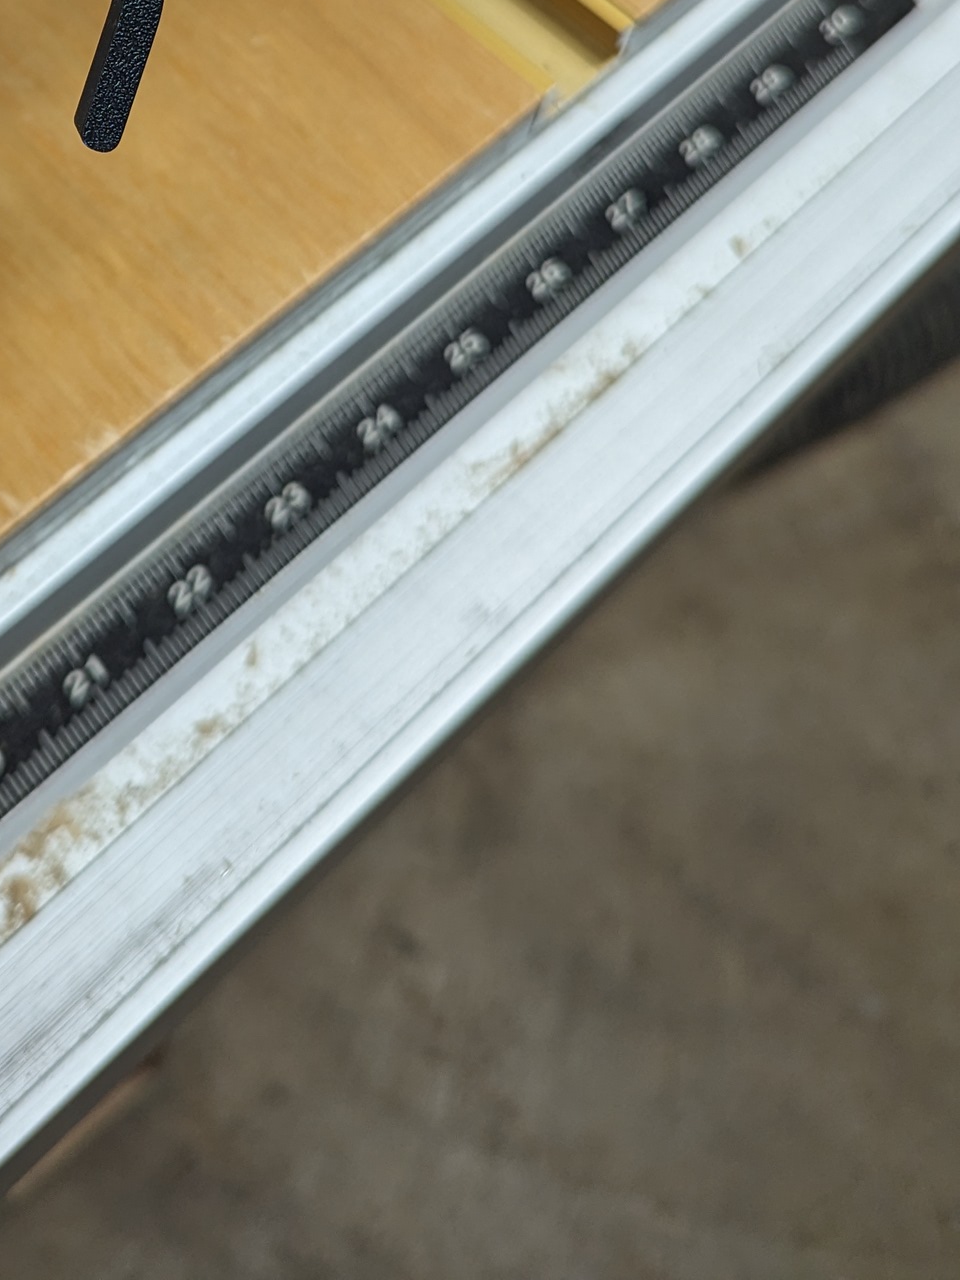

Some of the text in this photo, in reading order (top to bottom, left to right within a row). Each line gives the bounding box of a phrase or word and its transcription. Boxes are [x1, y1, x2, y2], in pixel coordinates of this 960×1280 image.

[750, 63, 795, 106] 29
[678, 123, 725, 168] 28
[605, 187, 647, 233] 27
[525, 256, 573, 303] 26
[444, 327, 490, 373] 25
[356, 403, 401, 453] 24
[264, 481, 313, 533] 23
[167, 563, 214, 617] 22
[63, 653, 110, 711] 21
